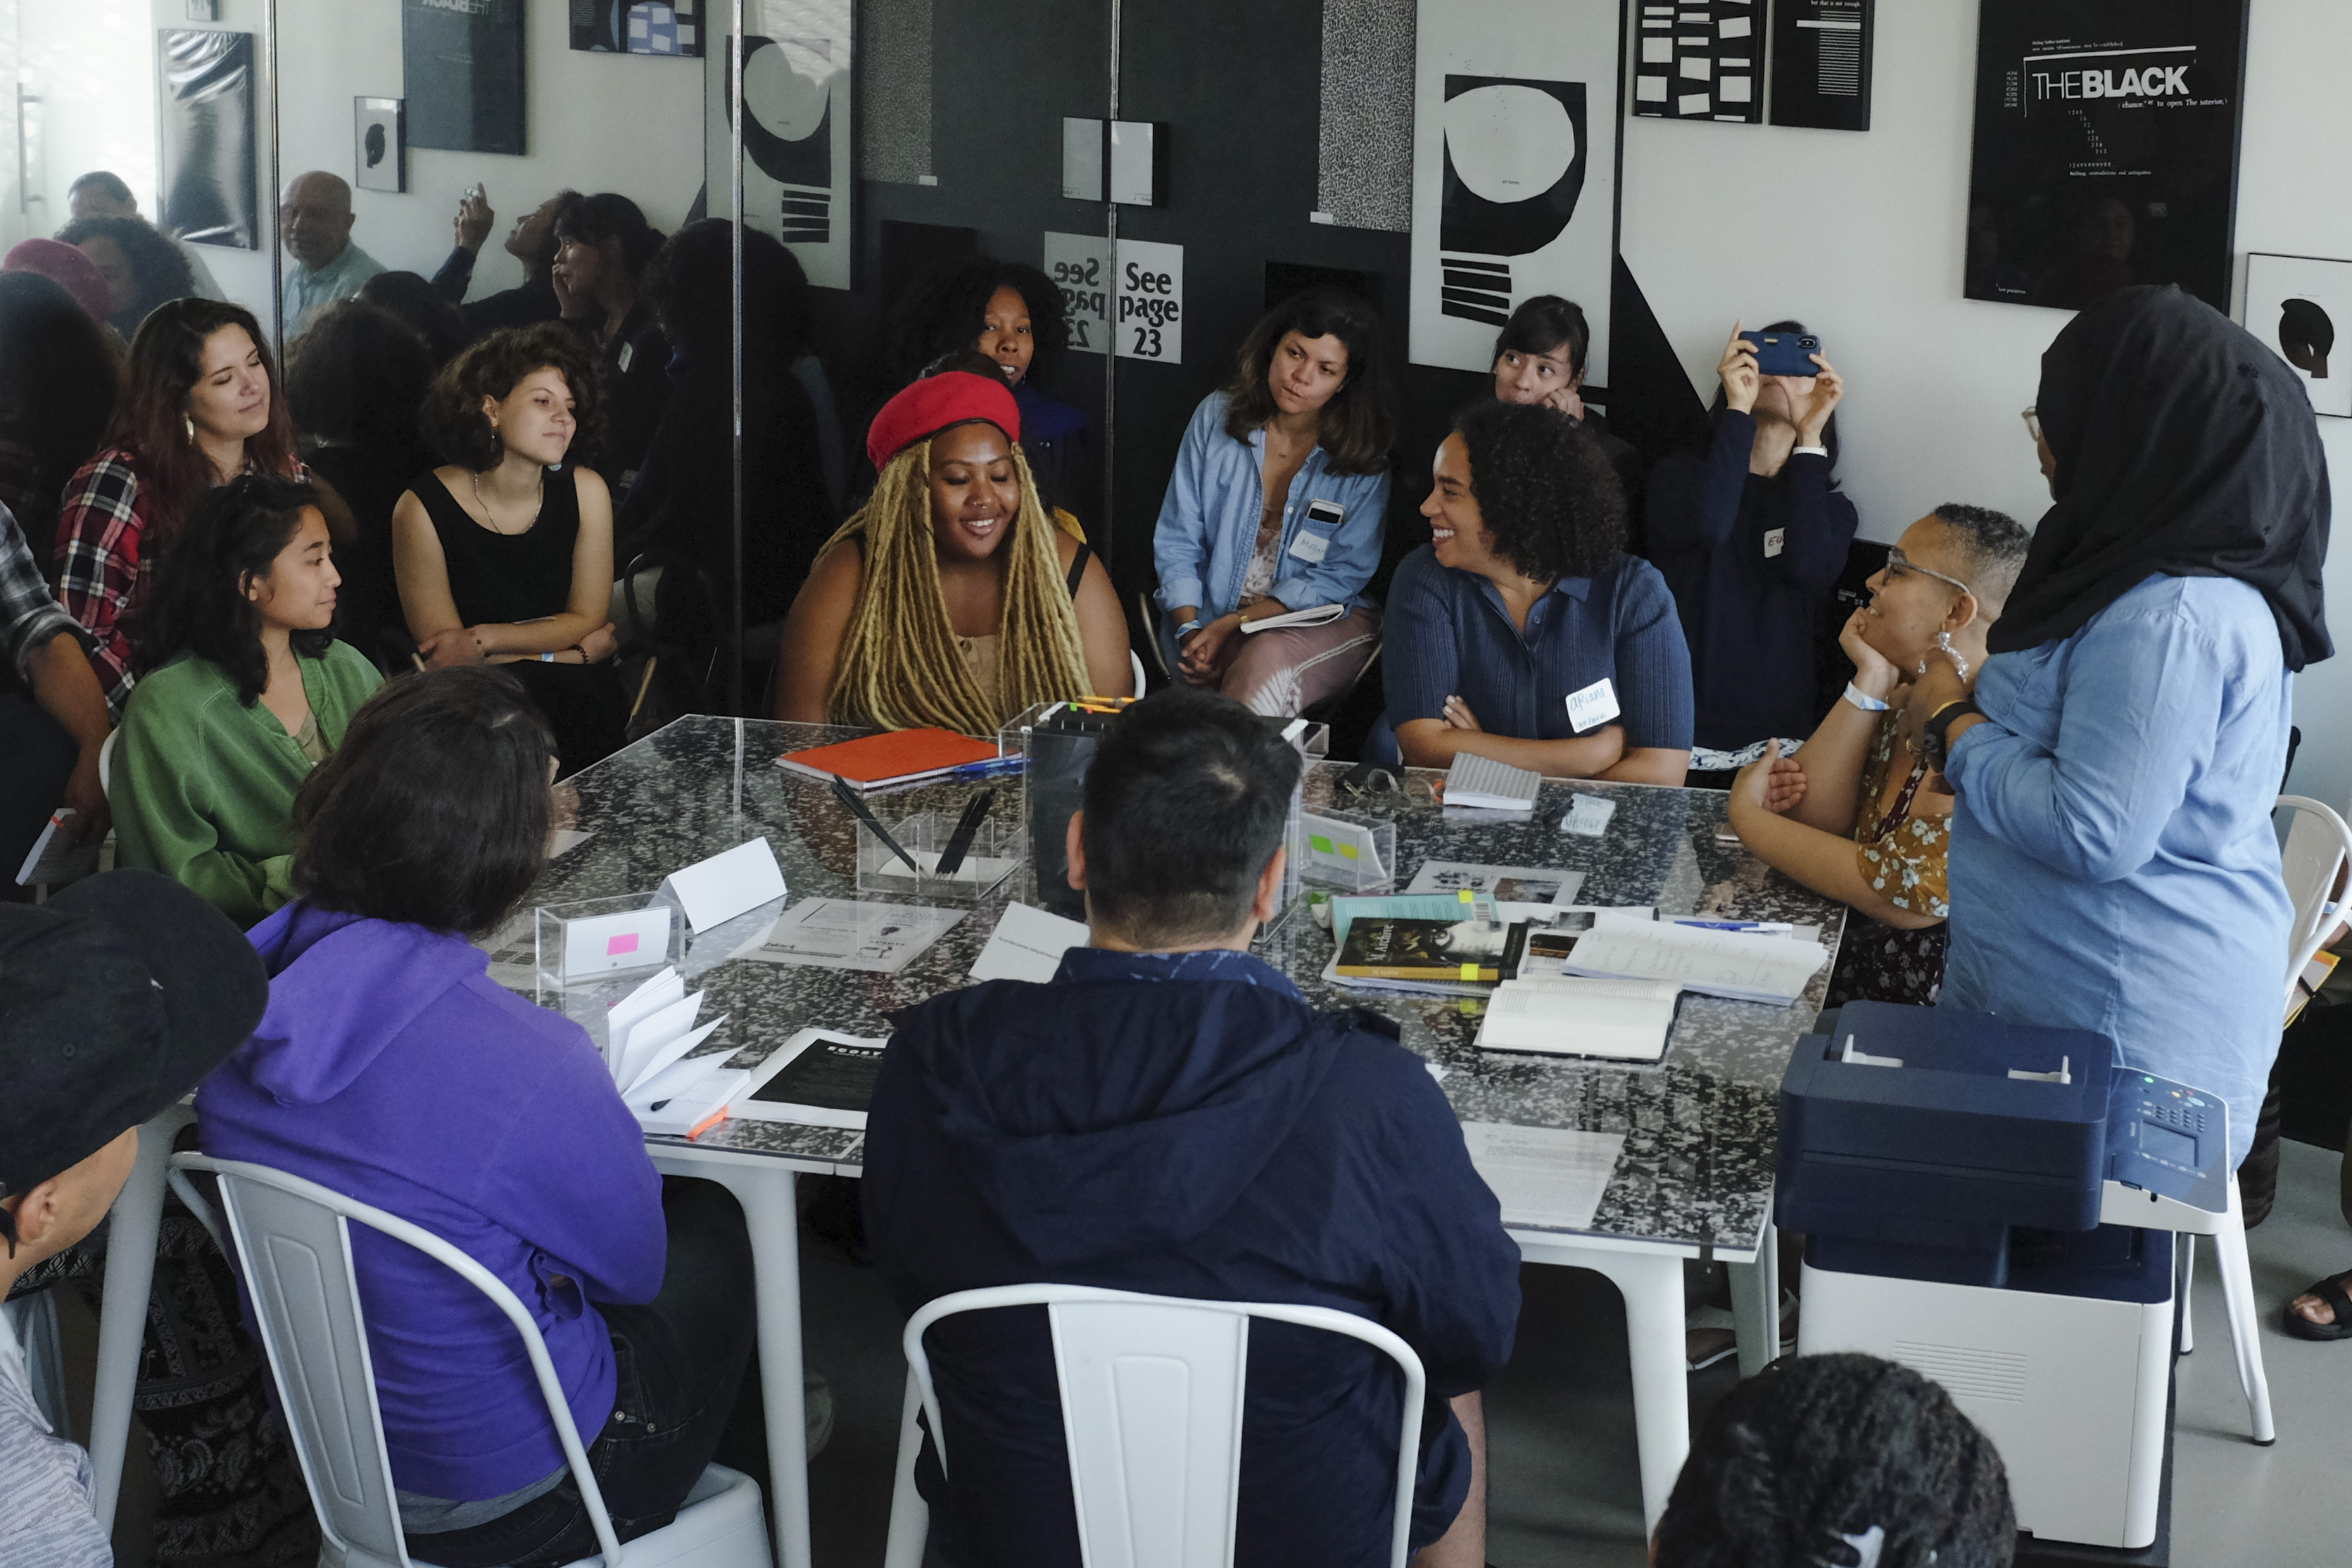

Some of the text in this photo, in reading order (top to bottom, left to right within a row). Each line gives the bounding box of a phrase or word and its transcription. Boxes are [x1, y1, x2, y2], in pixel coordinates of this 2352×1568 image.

[1126, 262, 1172, 294] See
[1119, 296, 1179, 327] page
[1133, 327, 1162, 357] 23
[1376, 923, 1394, 952] Archive
